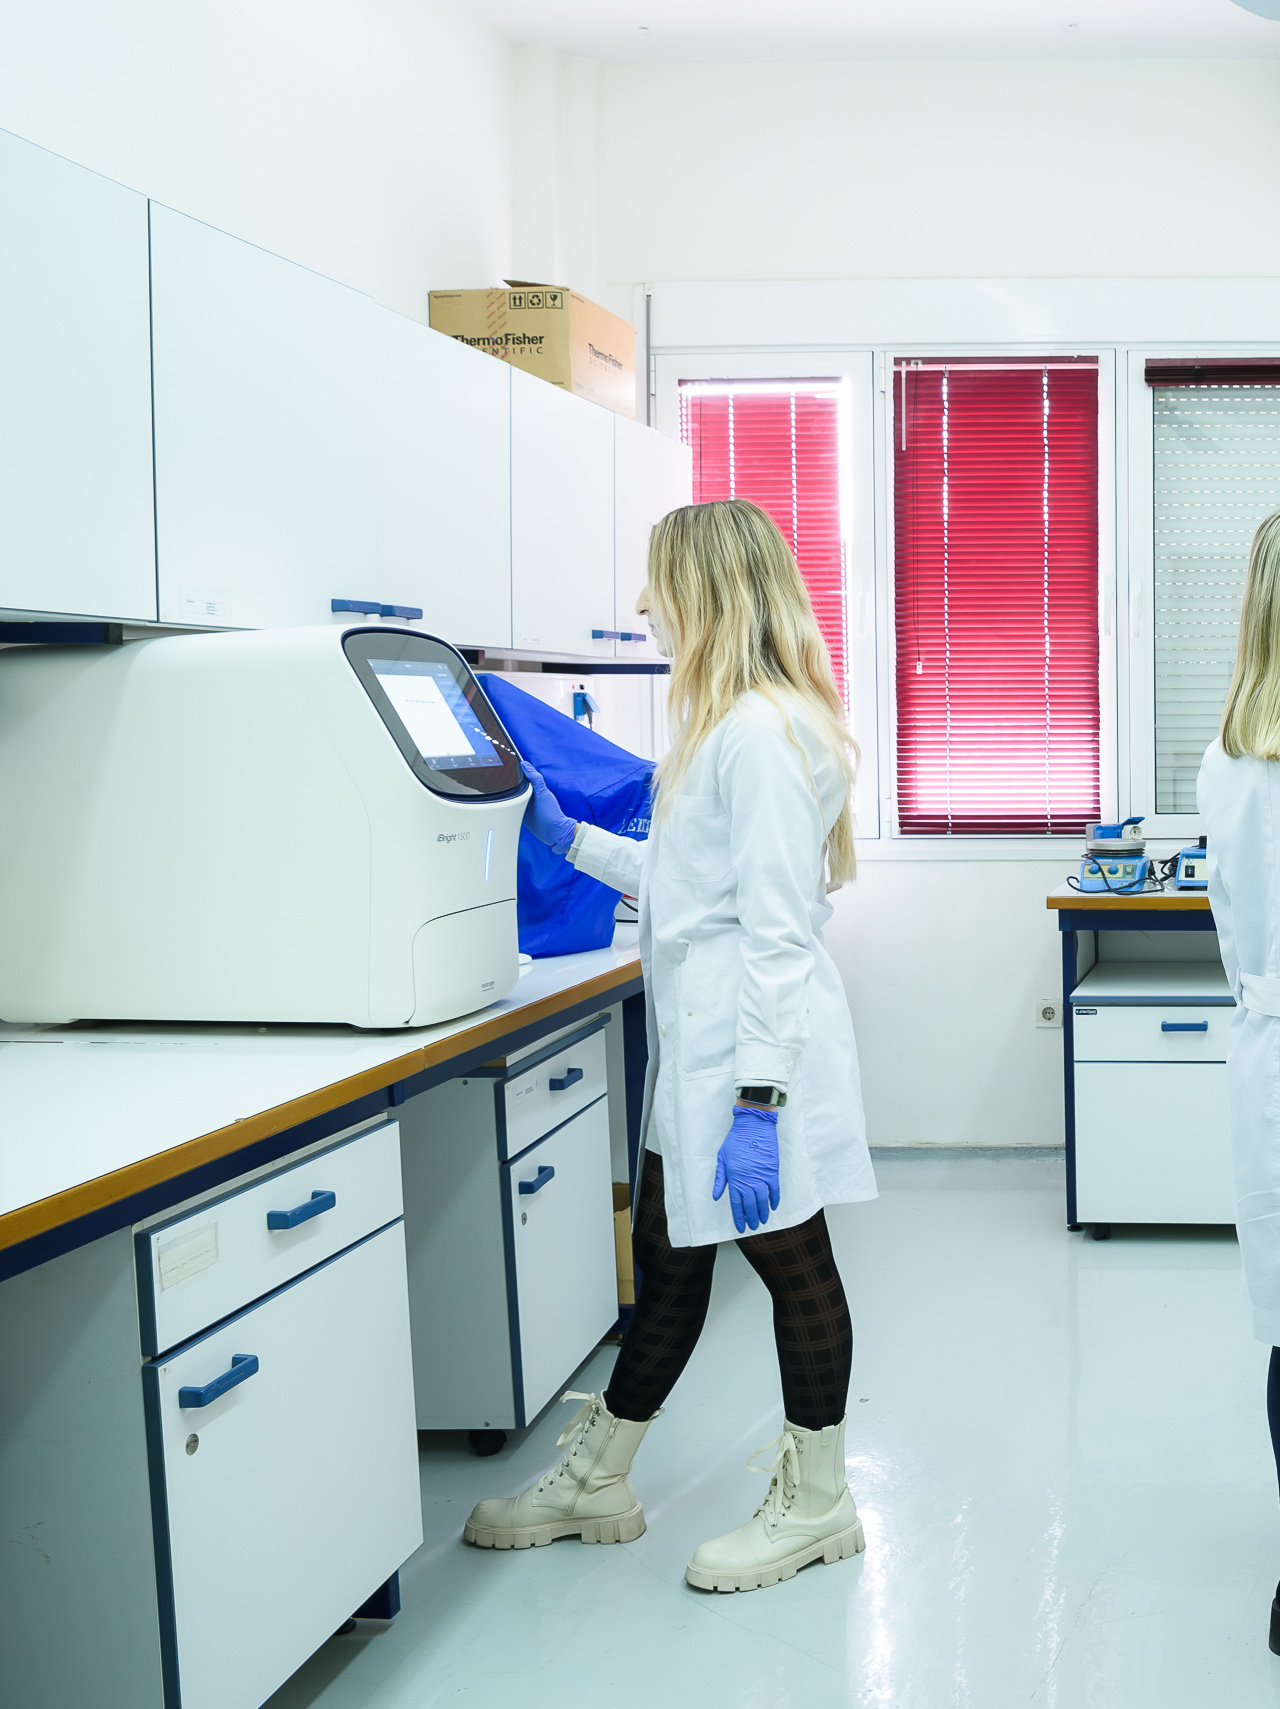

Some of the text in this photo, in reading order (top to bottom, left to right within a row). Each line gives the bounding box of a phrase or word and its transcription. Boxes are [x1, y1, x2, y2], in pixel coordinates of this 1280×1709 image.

[482, 346, 544, 355] ENTIFIC
[588, 342, 623, 370] ThermoFisher
[589, 356, 622, 377] SCIENTIF
[436, 832, 470, 844] iBright 1500
